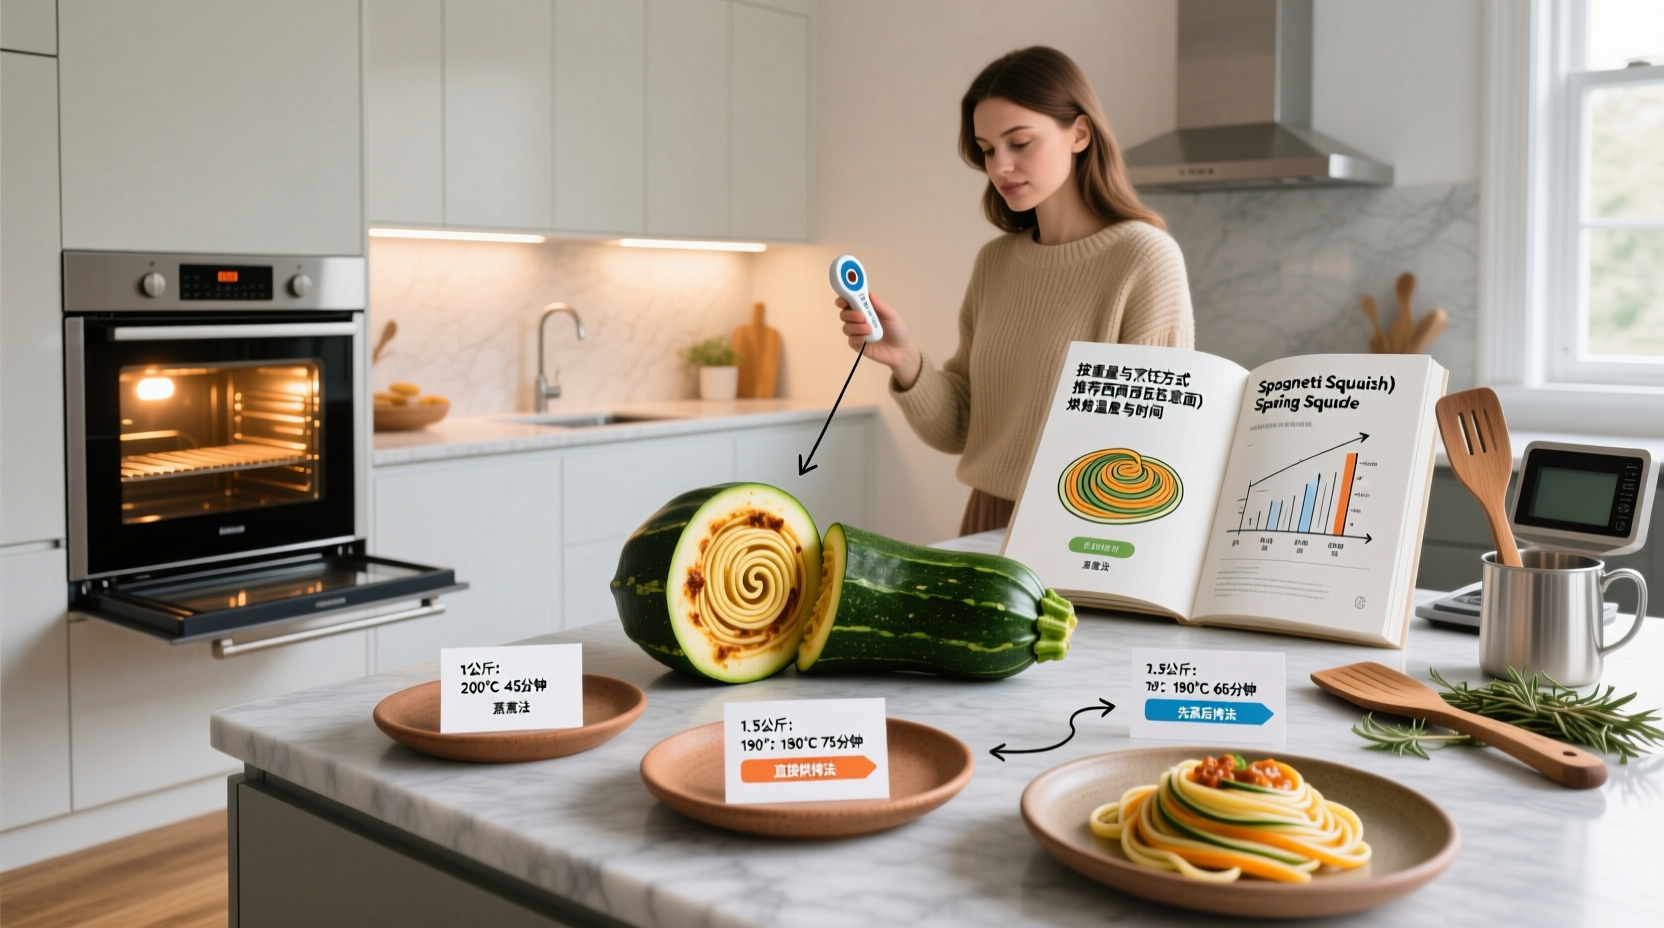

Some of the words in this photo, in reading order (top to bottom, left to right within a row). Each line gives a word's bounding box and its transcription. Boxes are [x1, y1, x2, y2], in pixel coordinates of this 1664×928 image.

[460, 661, 500, 676] 1公斤:
[503, 677, 547, 693] 45分钟
[820, 733, 864, 750] 75分钟
